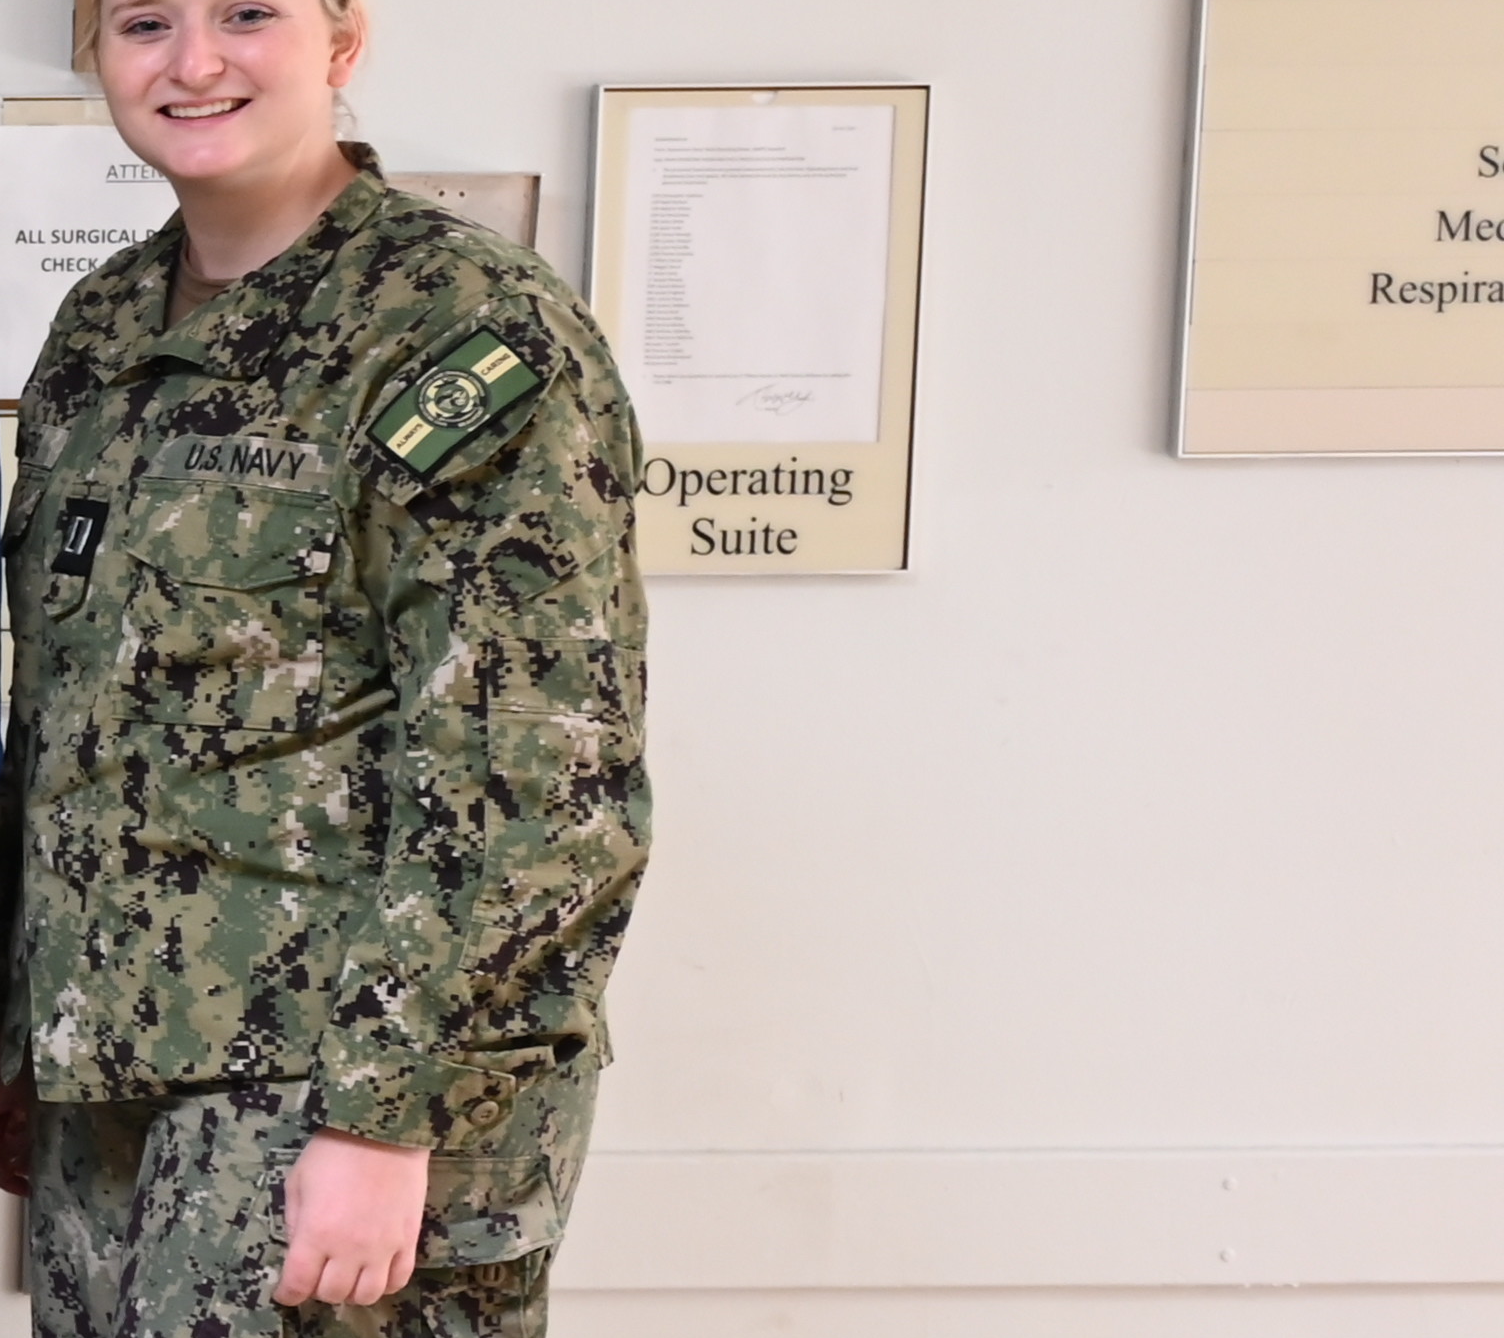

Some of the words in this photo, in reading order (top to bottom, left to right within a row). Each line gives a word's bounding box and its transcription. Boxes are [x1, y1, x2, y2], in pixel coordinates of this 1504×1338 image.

[15, 229, 45, 244] ALL
[51, 229, 139, 244] SURGICAL
[41, 257, 99, 272] CHECK
[480, 352, 512, 377] CARING
[184, 444, 223, 472] U.S.
[230, 445, 306, 480] NAVY
[642, 457, 854, 507] Operating
[690, 517, 798, 556] Suite
